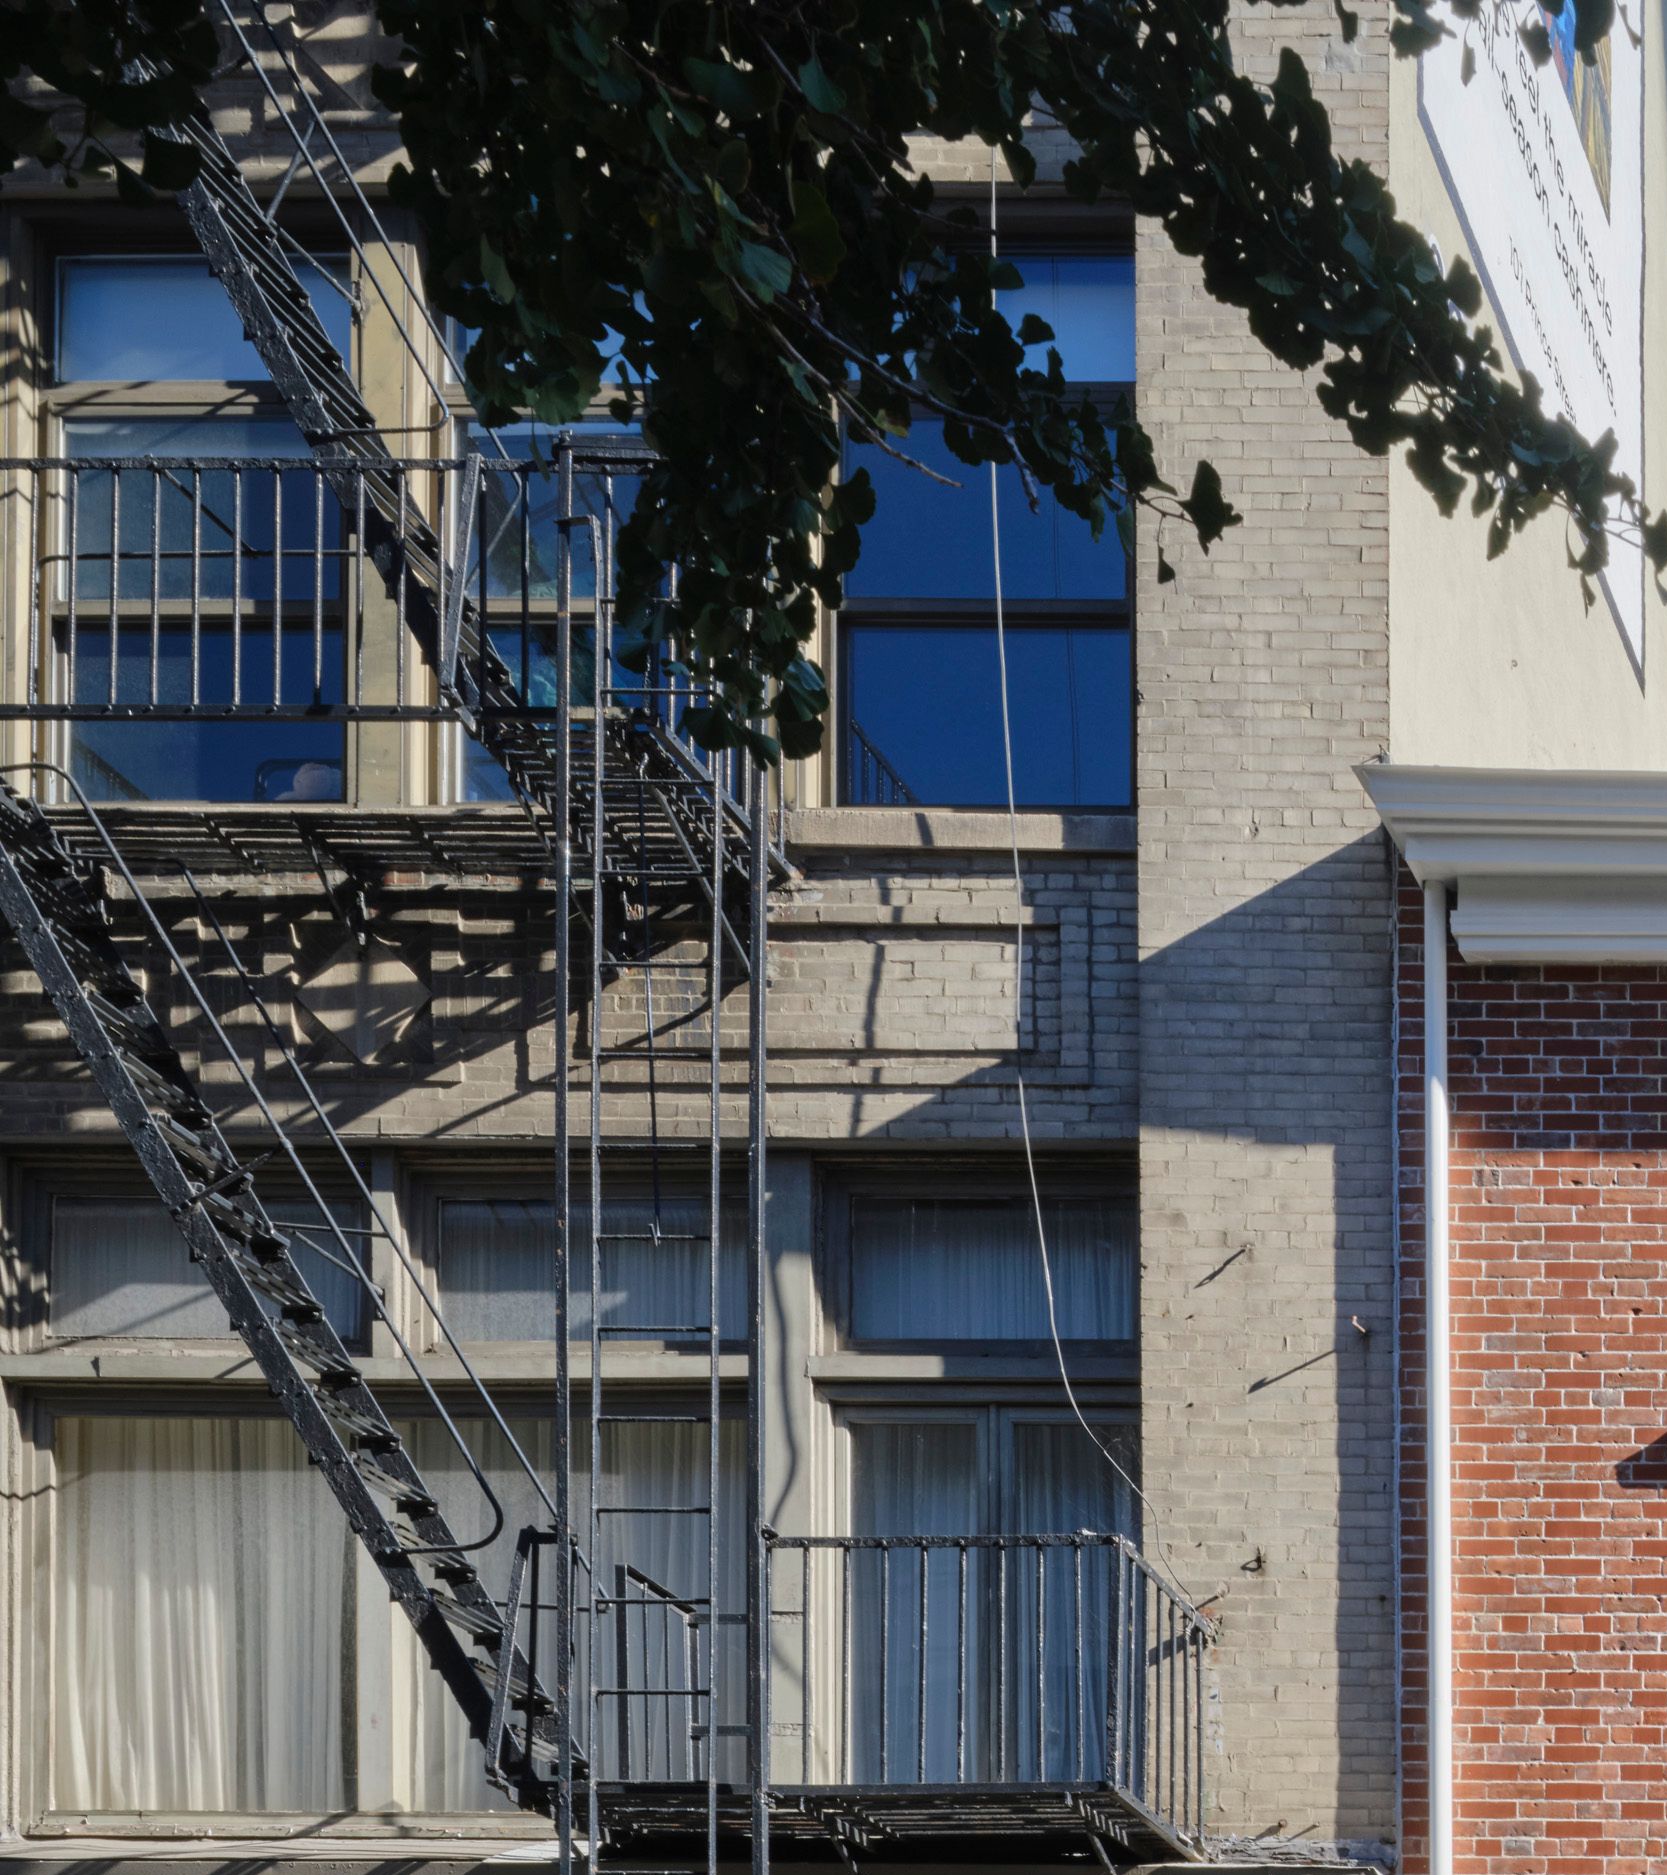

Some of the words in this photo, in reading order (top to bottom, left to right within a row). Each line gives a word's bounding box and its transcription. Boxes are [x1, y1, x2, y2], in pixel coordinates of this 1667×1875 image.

[1544, 112, 1564, 197] the
[1568, 190, 1612, 337] miracle
[1554, 222, 1617, 417] cashmere.
[1525, 278, 1552, 368] Prince
